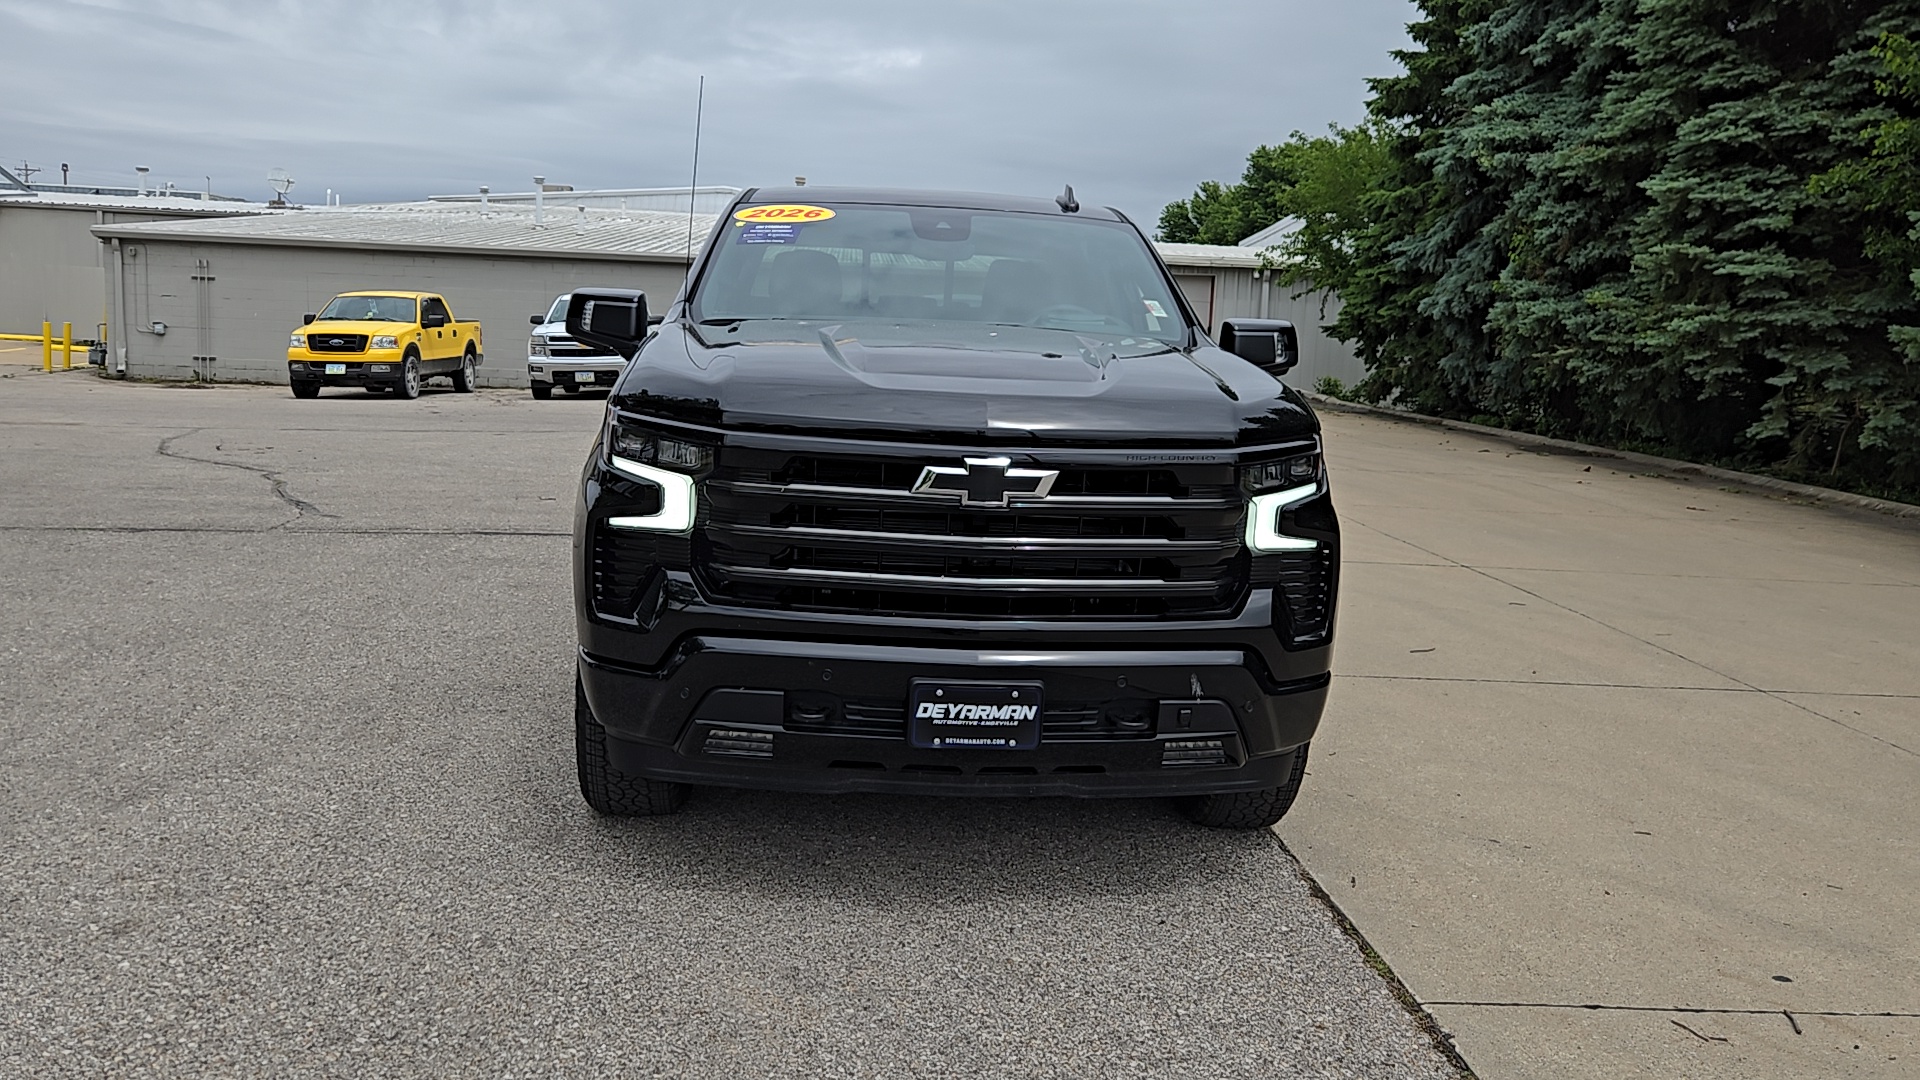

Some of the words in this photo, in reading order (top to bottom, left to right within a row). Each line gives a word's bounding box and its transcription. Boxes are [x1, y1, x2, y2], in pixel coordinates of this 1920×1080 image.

[744, 208, 825, 219] 2026
[915, 702, 1039, 721] DEYARMAN
[945, 737, 1006, 745] DEYARMANAUTO.COM
